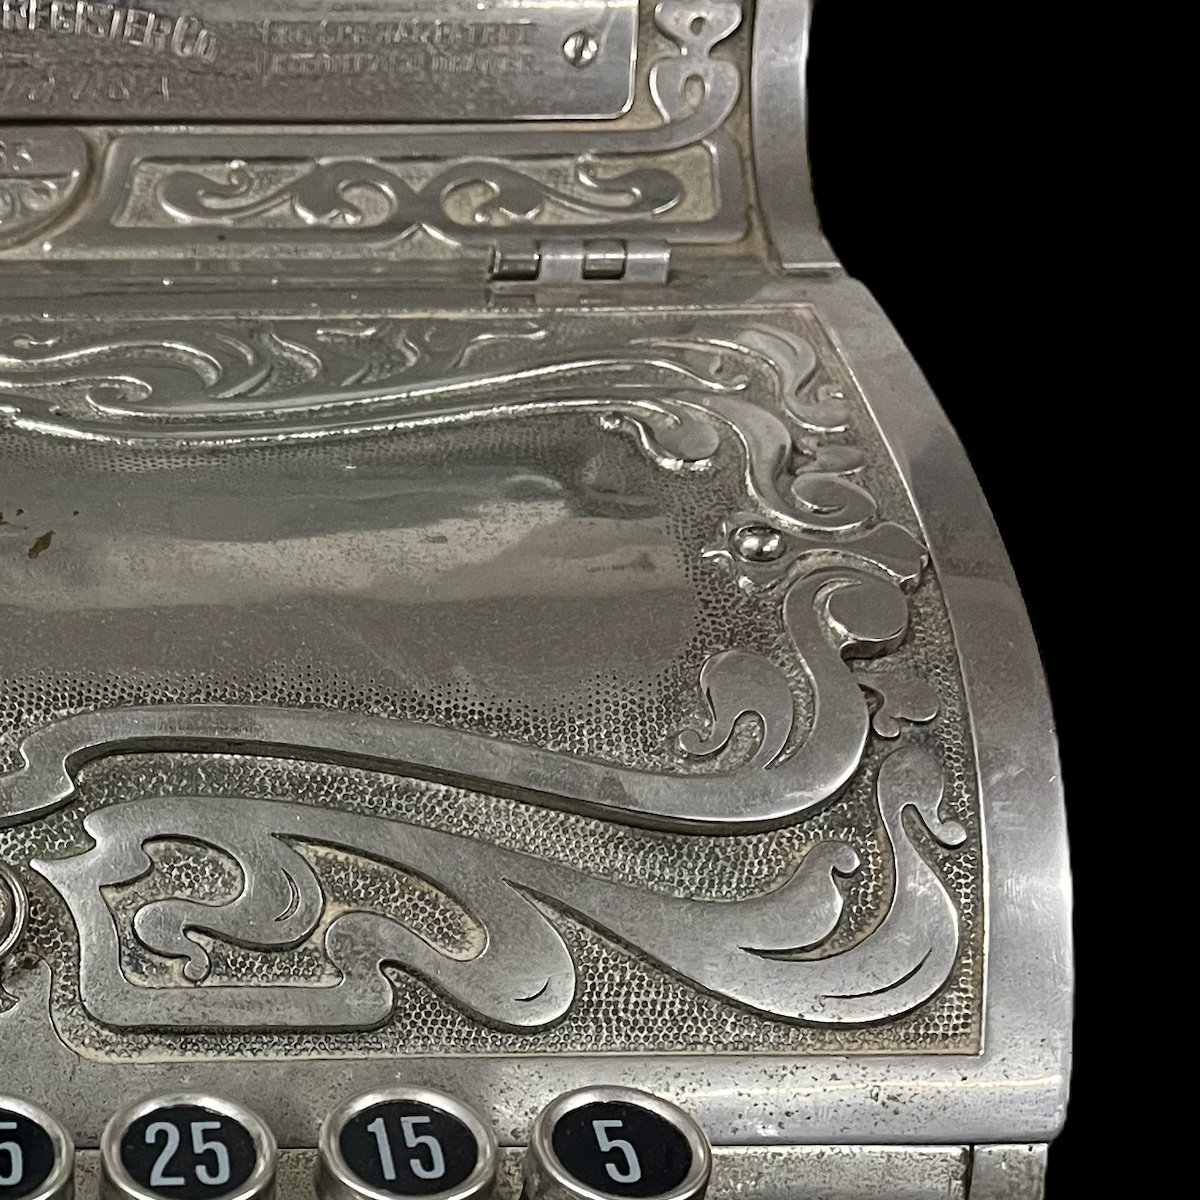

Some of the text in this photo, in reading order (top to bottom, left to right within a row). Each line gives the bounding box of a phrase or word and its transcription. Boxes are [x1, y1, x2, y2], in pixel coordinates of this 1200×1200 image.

[145, 1122, 229, 1186] 25
[368, 1116, 444, 1179] 15
[593, 1120, 641, 1182] 5
